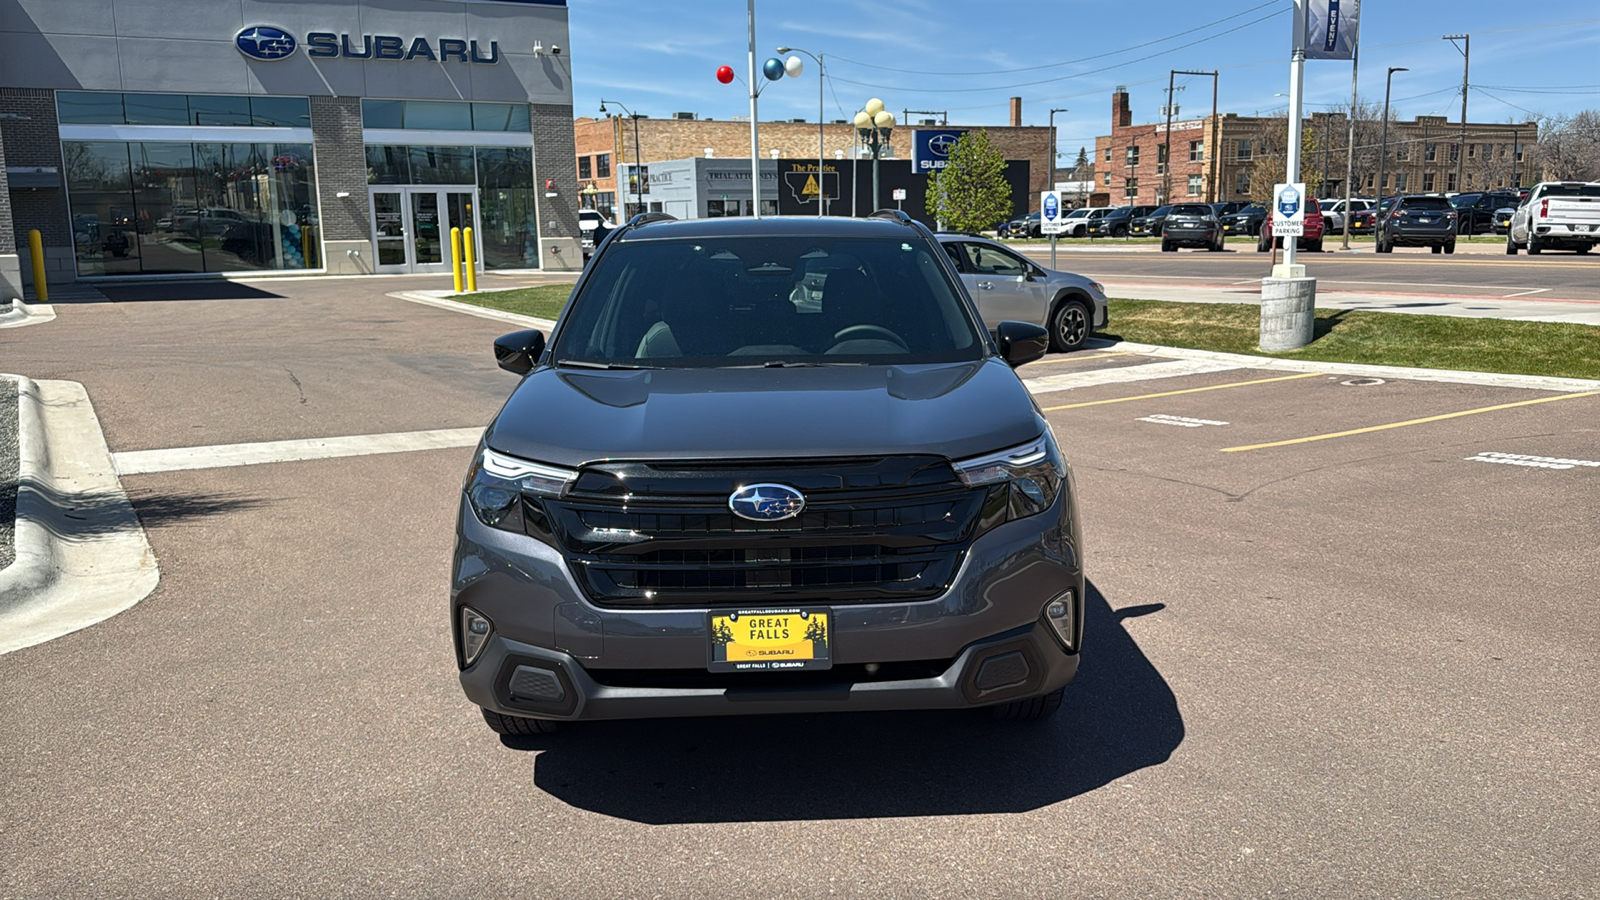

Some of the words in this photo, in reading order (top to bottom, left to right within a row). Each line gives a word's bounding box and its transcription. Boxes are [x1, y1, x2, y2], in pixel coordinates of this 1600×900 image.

[1328, 10, 1337, 46] EVENT
[306, 31, 499, 65] SUBARU
[791, 164, 806, 172] The
[807, 164, 836, 172] Pratice
[920, 160, 950, 169] SUB
[709, 172, 733, 180] TRIAL
[734, 172, 778, 180] ATTONEYS
[750, 618, 789, 628] GREAT
[750, 629, 789, 639] FALLS
